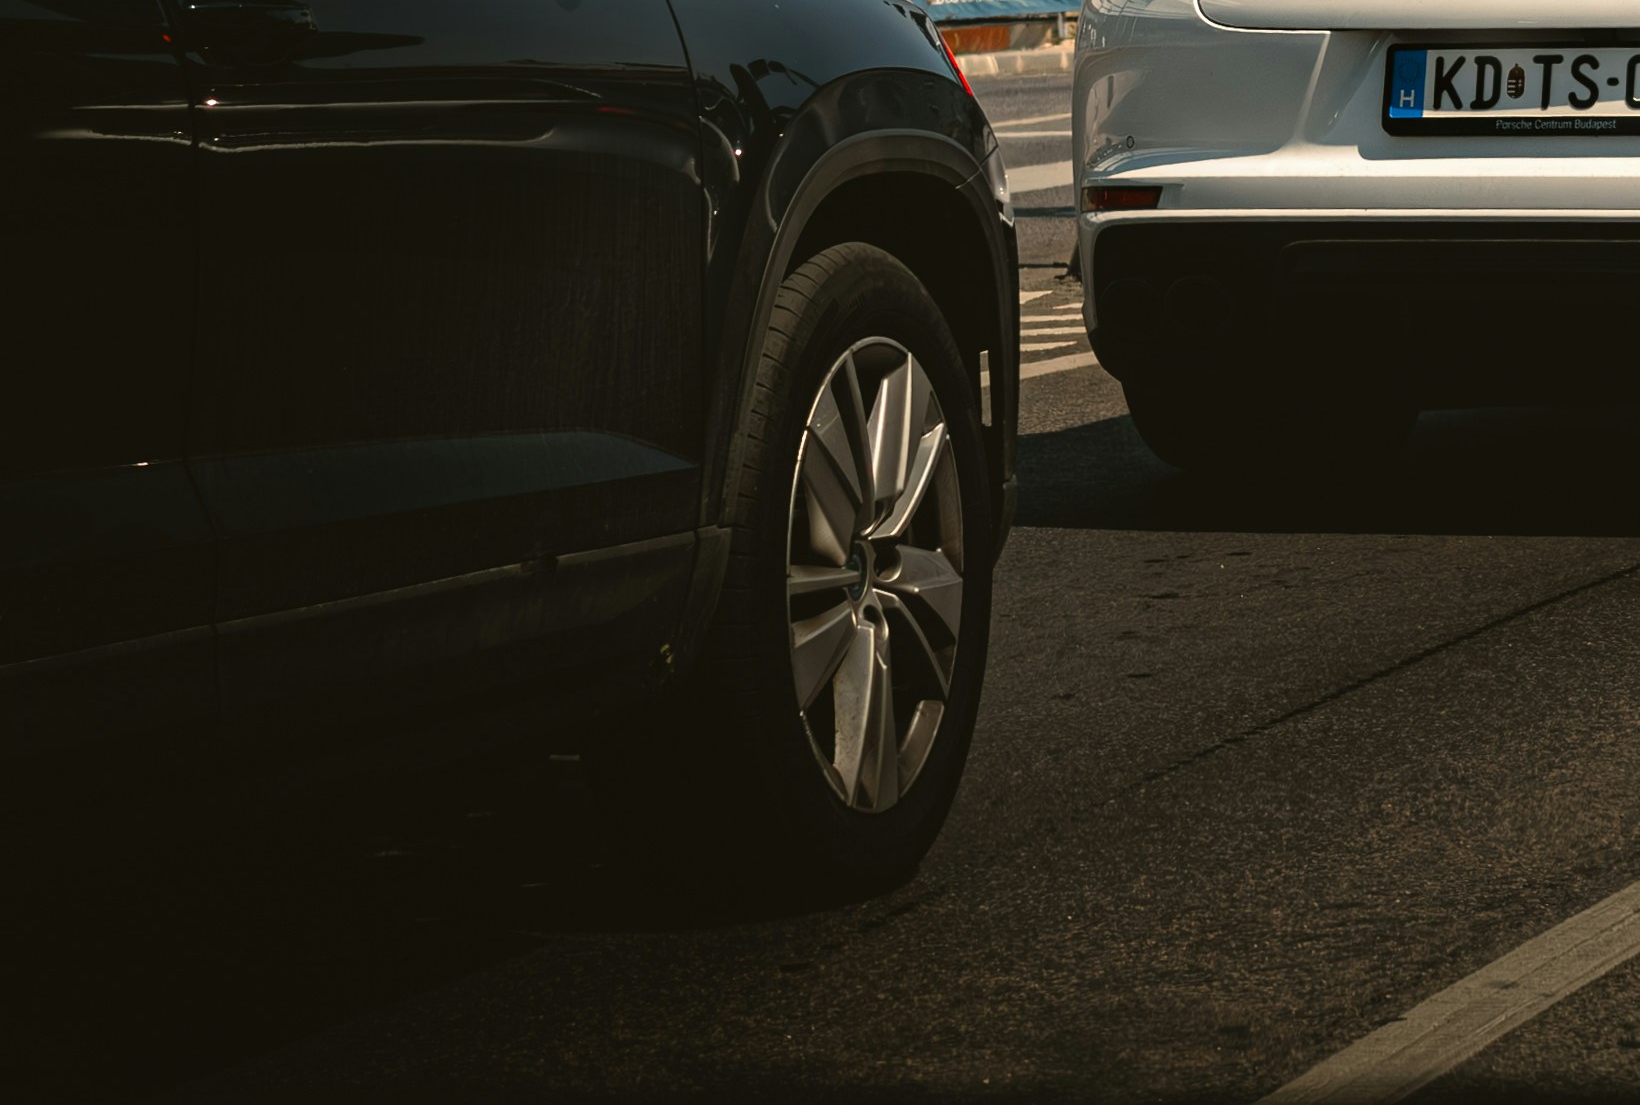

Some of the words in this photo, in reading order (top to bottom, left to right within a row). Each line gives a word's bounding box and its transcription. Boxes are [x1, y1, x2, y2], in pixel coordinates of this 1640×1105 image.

[1433, 55, 1500, 111] KD
[1401, 89, 1414, 108] H
[1496, 119, 1532, 130] Porsche
[1534, 119, 1572, 130] Centrum
[1574, 119, 1617, 131] Budapest
